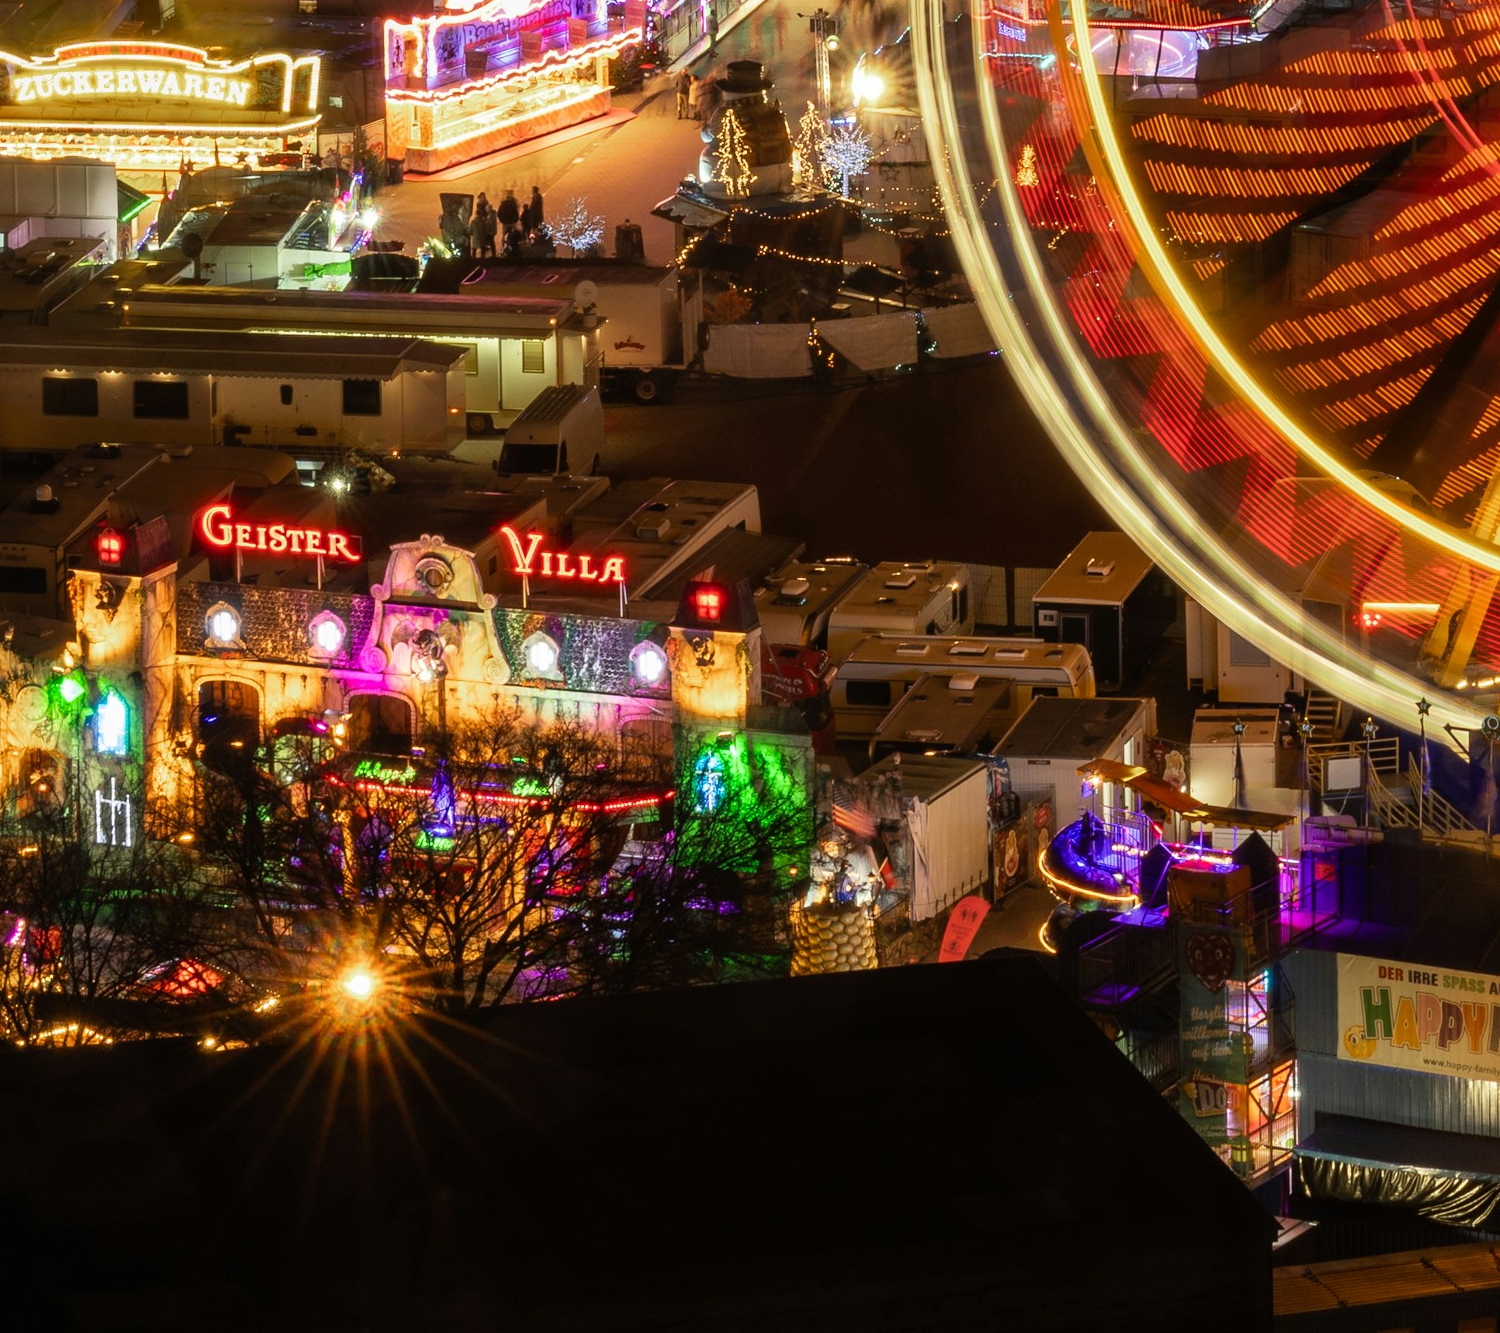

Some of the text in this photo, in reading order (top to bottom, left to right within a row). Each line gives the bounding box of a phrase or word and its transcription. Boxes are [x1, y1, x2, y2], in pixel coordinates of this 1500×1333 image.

[15, 69, 252, 107] ZUCKERWAREN
[202, 505, 626, 580] GEISTER VILLA
[1377, 965, 1406, 984] DER
[1407, 968, 1441, 988] IRRE
[1442, 973, 1487, 994] SPASS
